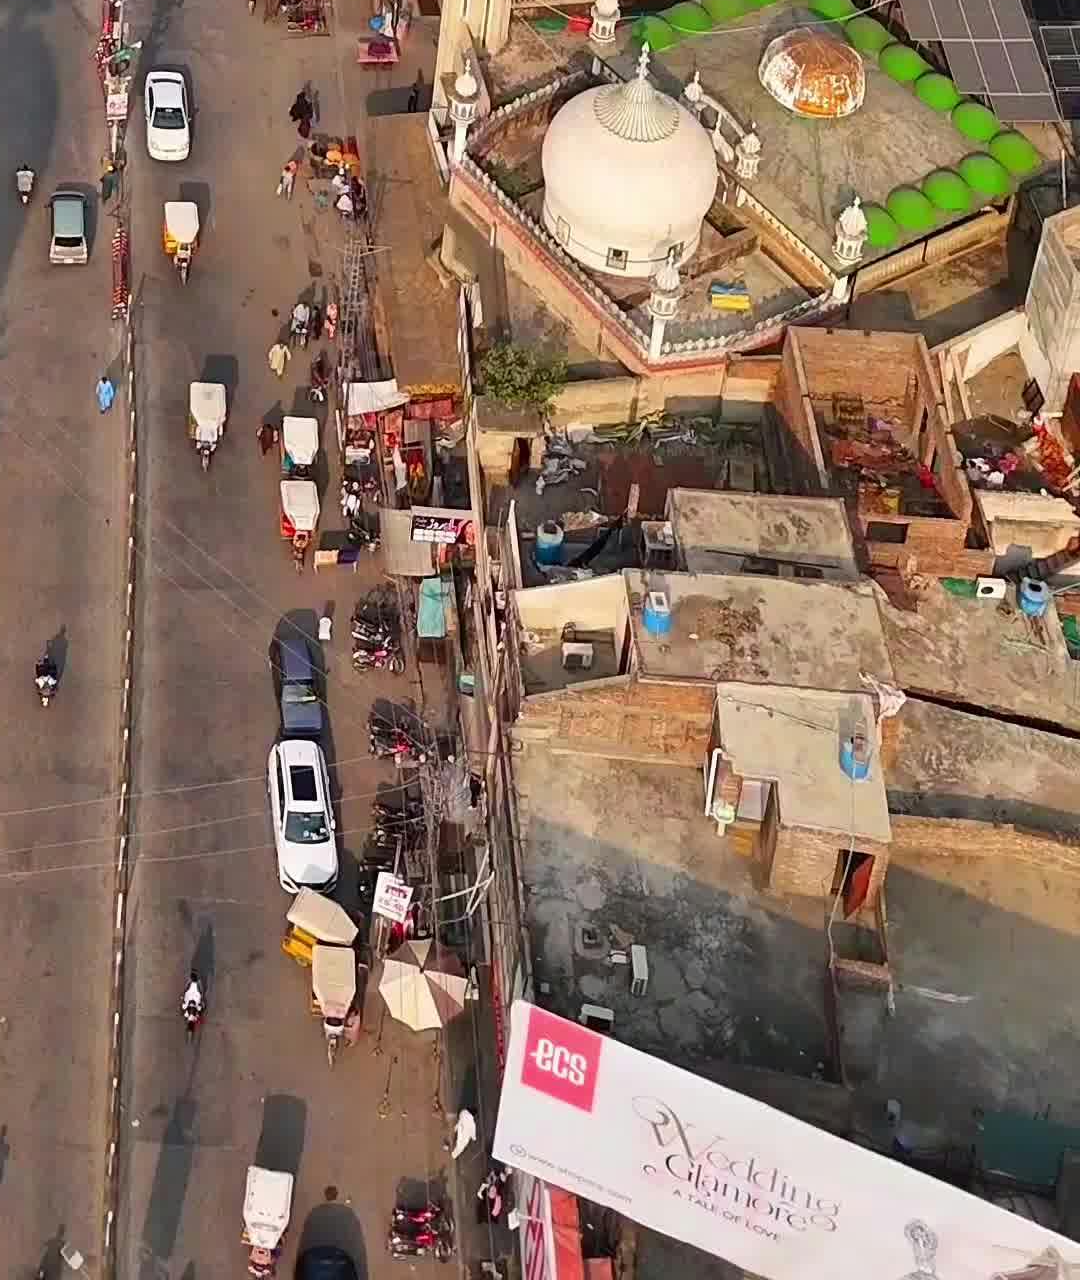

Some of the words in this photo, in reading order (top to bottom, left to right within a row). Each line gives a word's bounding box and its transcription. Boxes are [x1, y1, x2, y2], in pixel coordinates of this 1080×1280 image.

[531, 1039, 587, 1086] ecs
[688, 1196, 717, 1213] TALE
[722, 1210, 742, 1225] OF
[745, 1220, 781, 1242] LOVE
